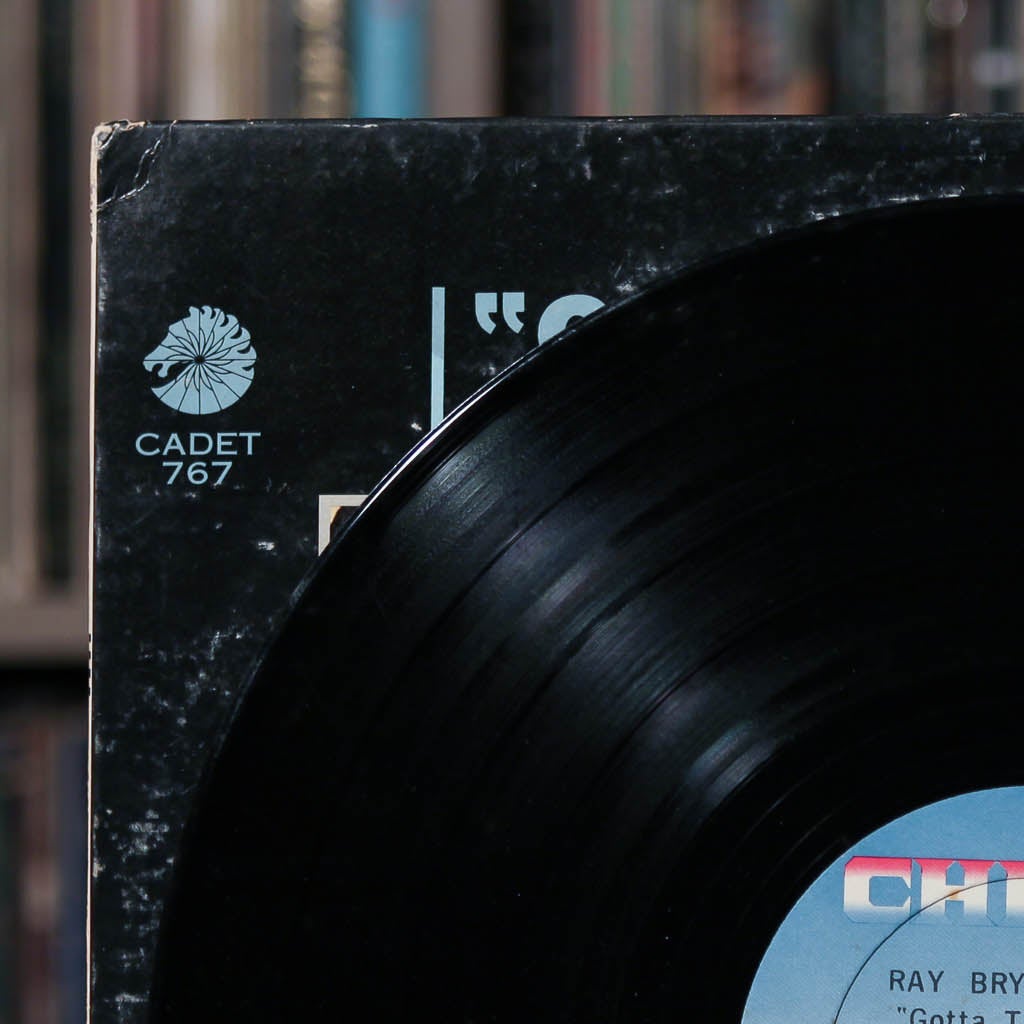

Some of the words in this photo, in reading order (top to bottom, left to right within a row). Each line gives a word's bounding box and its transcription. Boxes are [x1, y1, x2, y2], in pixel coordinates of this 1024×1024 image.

[135, 432, 261, 456] CADET
[162, 461, 233, 486] 767
[889, 969, 945, 993] RAY
